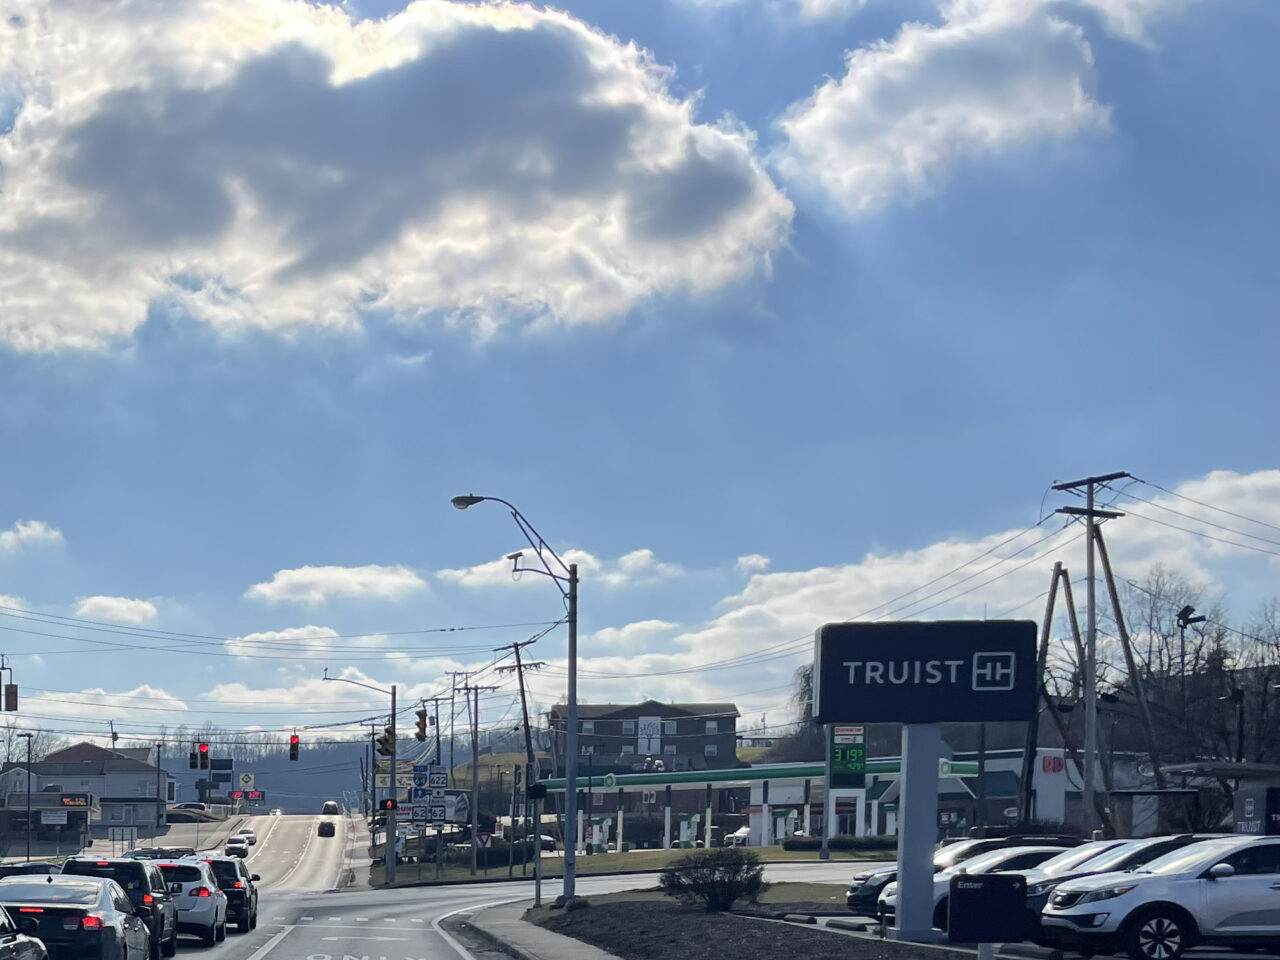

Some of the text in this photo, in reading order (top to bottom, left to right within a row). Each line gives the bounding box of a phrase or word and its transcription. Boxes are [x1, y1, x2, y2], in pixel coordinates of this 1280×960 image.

[842, 660, 964, 684] TRUIST
[431, 776, 446, 784] 622
[413, 809, 425, 817] 62
[433, 809, 444, 817] 62
[1237, 820, 1261, 832] TRUIST
[958, 881, 983, 889] Enter
